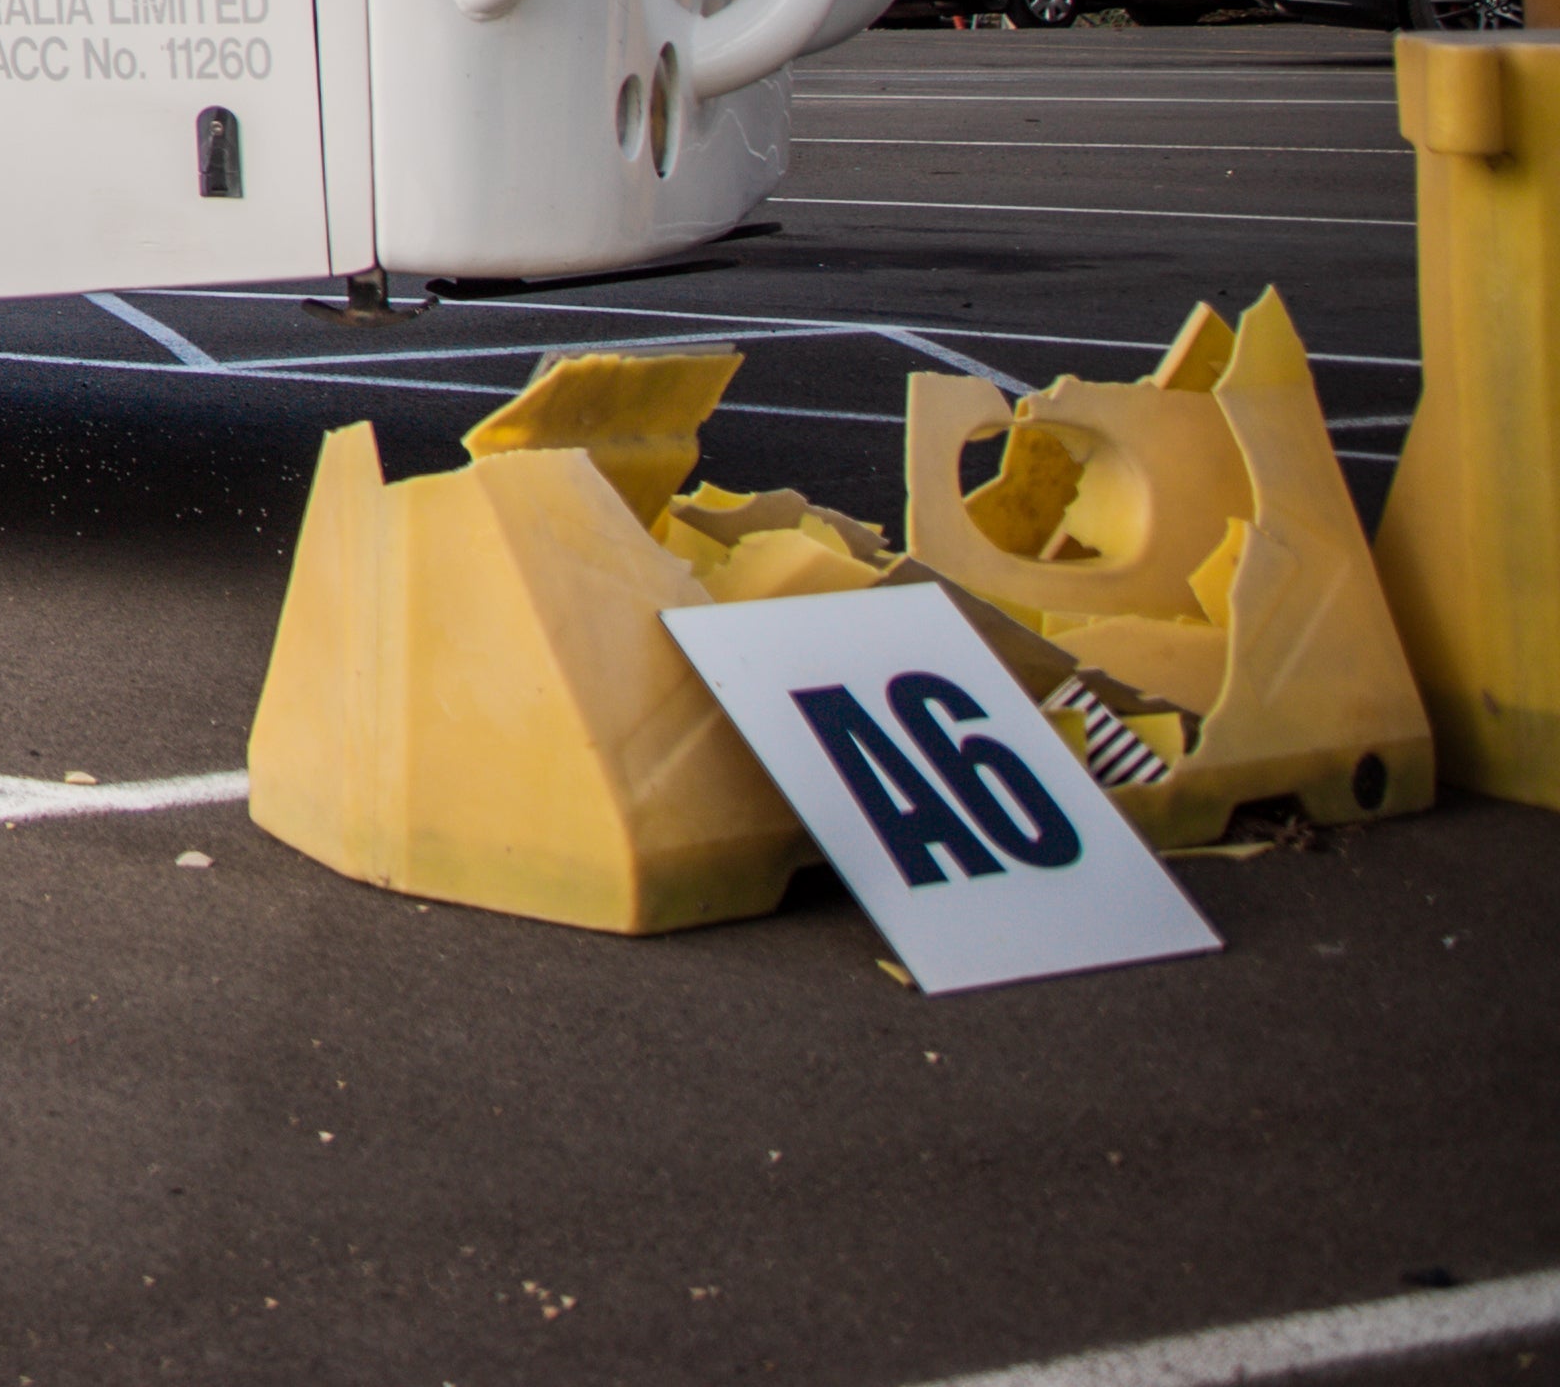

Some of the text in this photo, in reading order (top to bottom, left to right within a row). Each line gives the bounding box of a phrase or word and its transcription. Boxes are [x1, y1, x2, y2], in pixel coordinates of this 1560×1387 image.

[83, 36, 147, 81] No.
[160, 36, 273, 81] 11260
[786, 670, 1084, 889] A6
